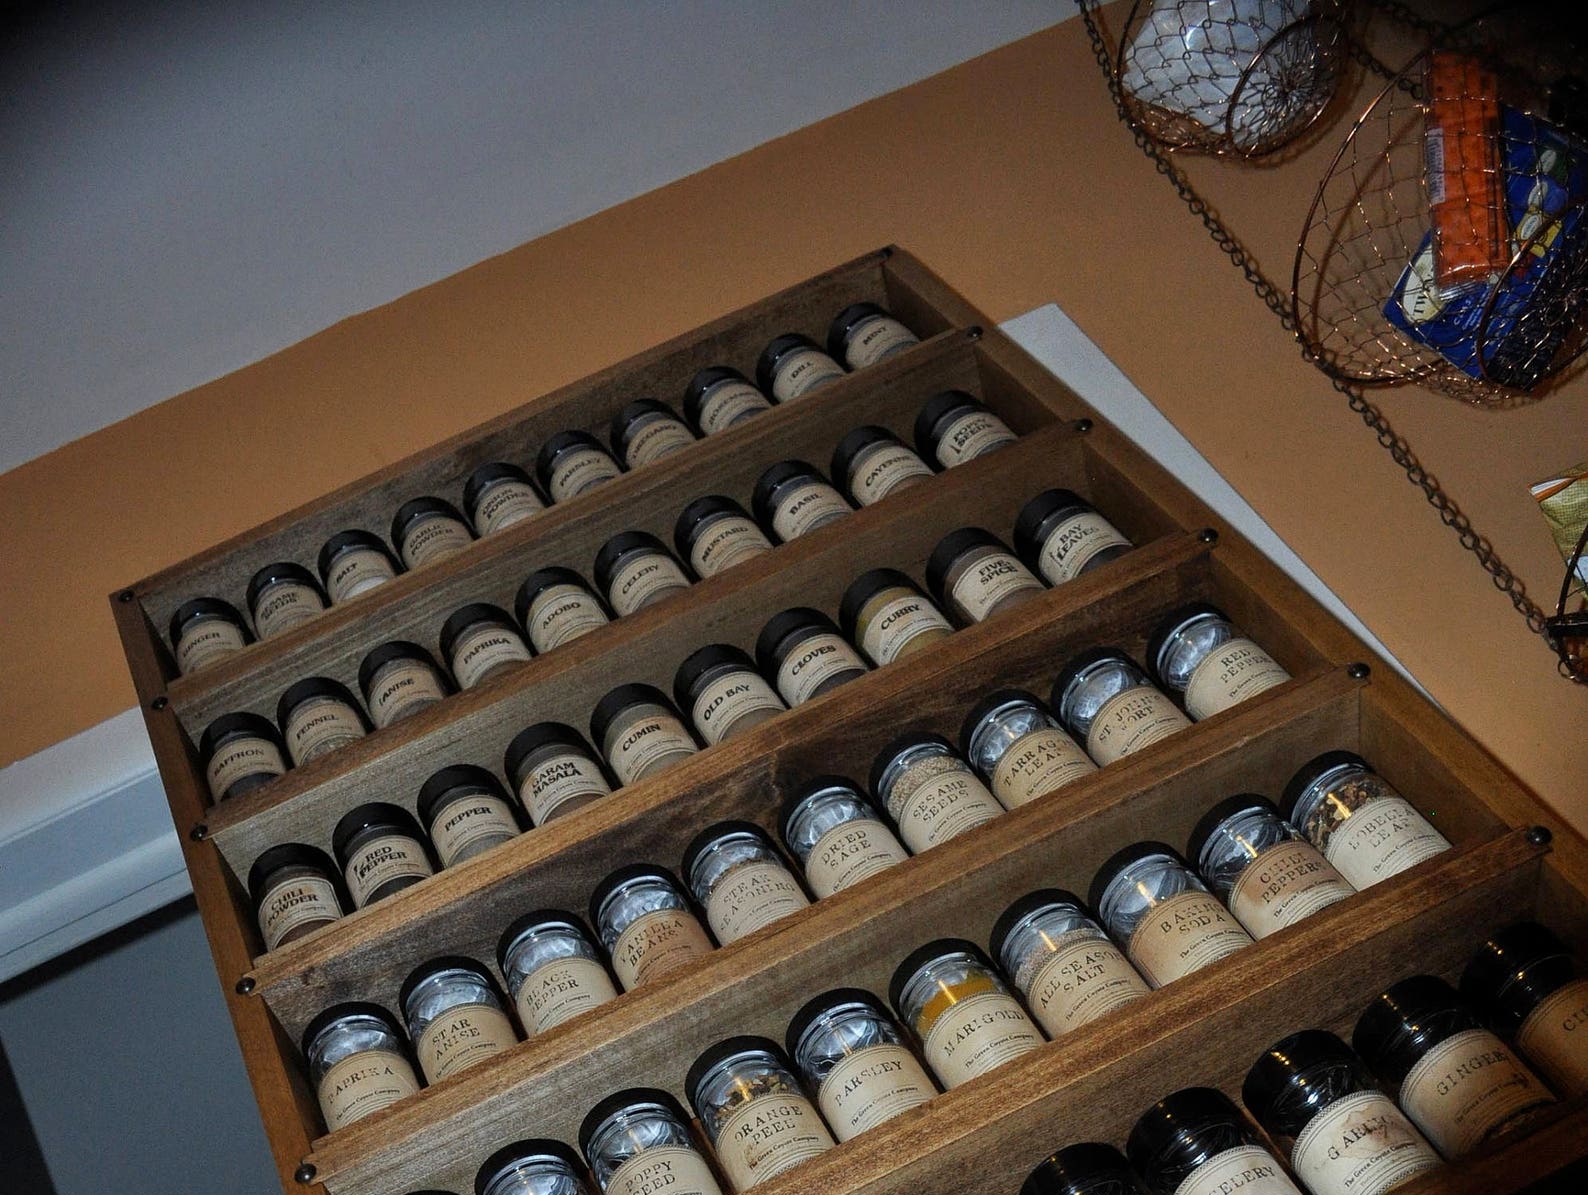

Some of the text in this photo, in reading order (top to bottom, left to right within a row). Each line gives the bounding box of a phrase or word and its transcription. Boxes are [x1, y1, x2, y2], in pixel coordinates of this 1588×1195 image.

[791, 361, 811, 379] DILL
[560, 457, 600, 487] PARSLEY
[865, 454, 910, 487] CAYENNE
[789, 492, 822, 515] BASIL
[702, 527, 749, 562] MUSTARD
[1056, 526, 1100, 561] LEAVES
[1059, 523, 1083, 544] BAY
[336, 562, 357, 583] SALT
[622, 564, 659, 595] CELERY
[978, 560, 1009, 577] FIVE
[980, 564, 1018, 586] SPICE
[542, 602, 580, 630] ADOBO
[880, 603, 921, 631] CURRY
[183, 632, 220, 657] GINGER
[463, 636, 511, 664] PAPRIKA
[1220, 648, 1252, 668] RED
[791, 644, 837, 676] CLOVES
[1220, 655, 1273, 684] PEPPER
[703, 696, 724, 721] OLD
[725, 684, 751, 702] BAY
[296, 714, 338, 740] FENNEL
[622, 723, 661, 752] CUMIN
[1098, 723, 1113, 742] ST
[213, 747, 264, 777] SAFFRON
[531, 761, 576, 789] GARAM
[532, 769, 583, 798] MASALA
[912, 780, 967, 819] SESAME
[923, 790, 970, 822] SEEDS
[444, 806, 493, 831] PEPPER
[1348, 808, 1415, 850] LOBELIA
[366, 846, 393, 862] RED
[821, 829, 867, 865] DRIED
[829, 849, 872, 869] SAGE
[360, 852, 408, 878] PEPPER
[271, 888, 304, 912] CHILI
[723, 873, 771, 904] STEAK
[267, 894, 319, 927] POWDER
[1160, 902, 1225, 934] BAKING
[1179, 913, 1225, 935] SODA
[630, 929, 681, 967] BEANS
[526, 969, 572, 1007] BLACK
[1040, 977, 1062, 1009] ALL
[1063, 964, 1106, 993] SALT
[530, 979, 579, 1018] PEPPER
[432, 1017, 471, 1045] STAR
[436, 1027, 480, 1061] ANISE
[943, 1008, 1025, 1057] MARIGOLD
[328, 1066, 394, 1104] PAPRIKA
[834, 1060, 903, 1107] PARSLEY
[1436, 1050, 1506, 1096] GINGER
[734, 1105, 803, 1143] ORANGE
[752, 1118, 796, 1145] PEEL
[624, 1160, 673, 1193] POPPY
